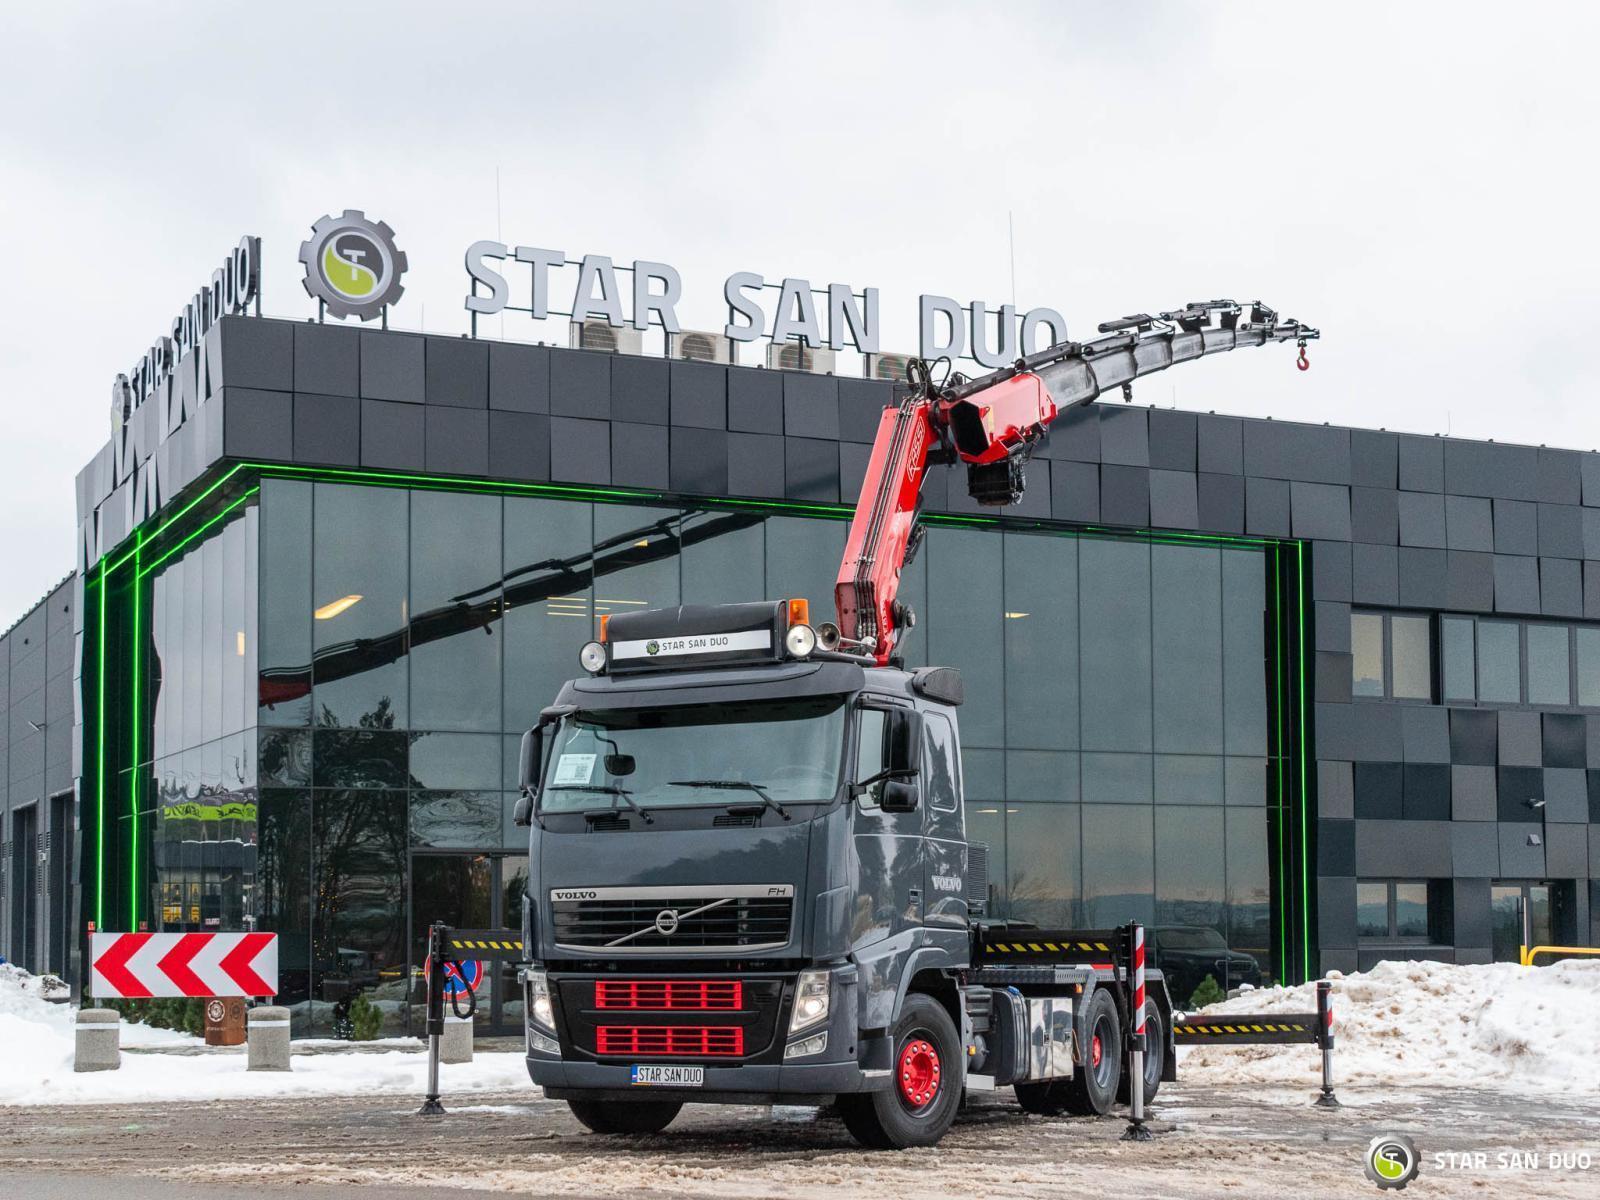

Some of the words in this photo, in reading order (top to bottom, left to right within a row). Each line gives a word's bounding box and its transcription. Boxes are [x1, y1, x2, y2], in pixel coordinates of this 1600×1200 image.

[465, 240, 682, 334] STAR
[724, 271, 880, 355] SAN
[919, 294, 1068, 370] DUO
[131, 336, 170, 409] STAR
[212, 235, 257, 327] DUO
[662, 640, 685, 651] STAR
[688, 639, 707, 649] SAN
[710, 636, 729, 647] DUO
[932, 875, 962, 892] VOLVO
[555, 891, 597, 900] VOLVO
[768, 887, 786, 896] FH
[639, 1067, 662, 1082] STAR
[664, 1068, 682, 1082] SAN
[683, 1068, 702, 1083] DUO
